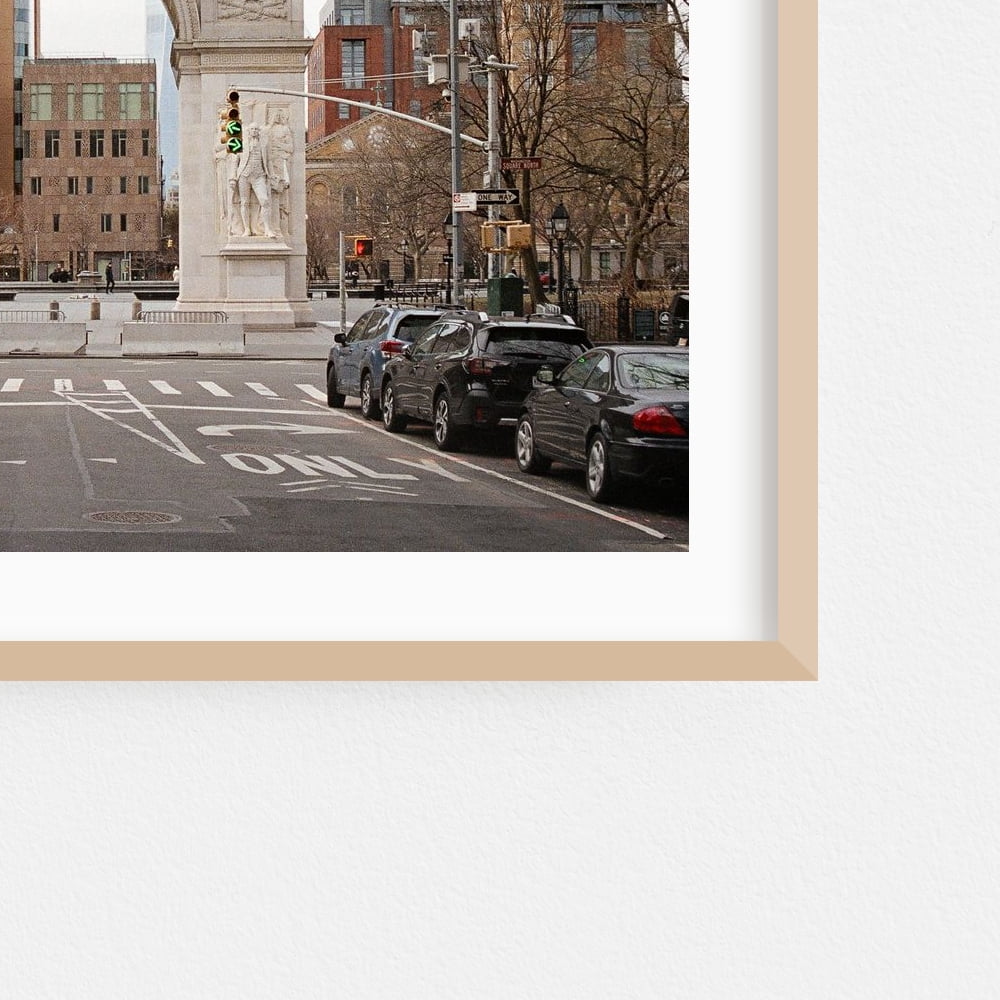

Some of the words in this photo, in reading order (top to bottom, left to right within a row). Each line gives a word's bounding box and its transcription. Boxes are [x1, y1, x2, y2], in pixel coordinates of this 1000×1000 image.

[478, 193, 491, 201] ONE
[498, 193, 513, 201] WAY
[220, 452, 472, 482] ONLY
